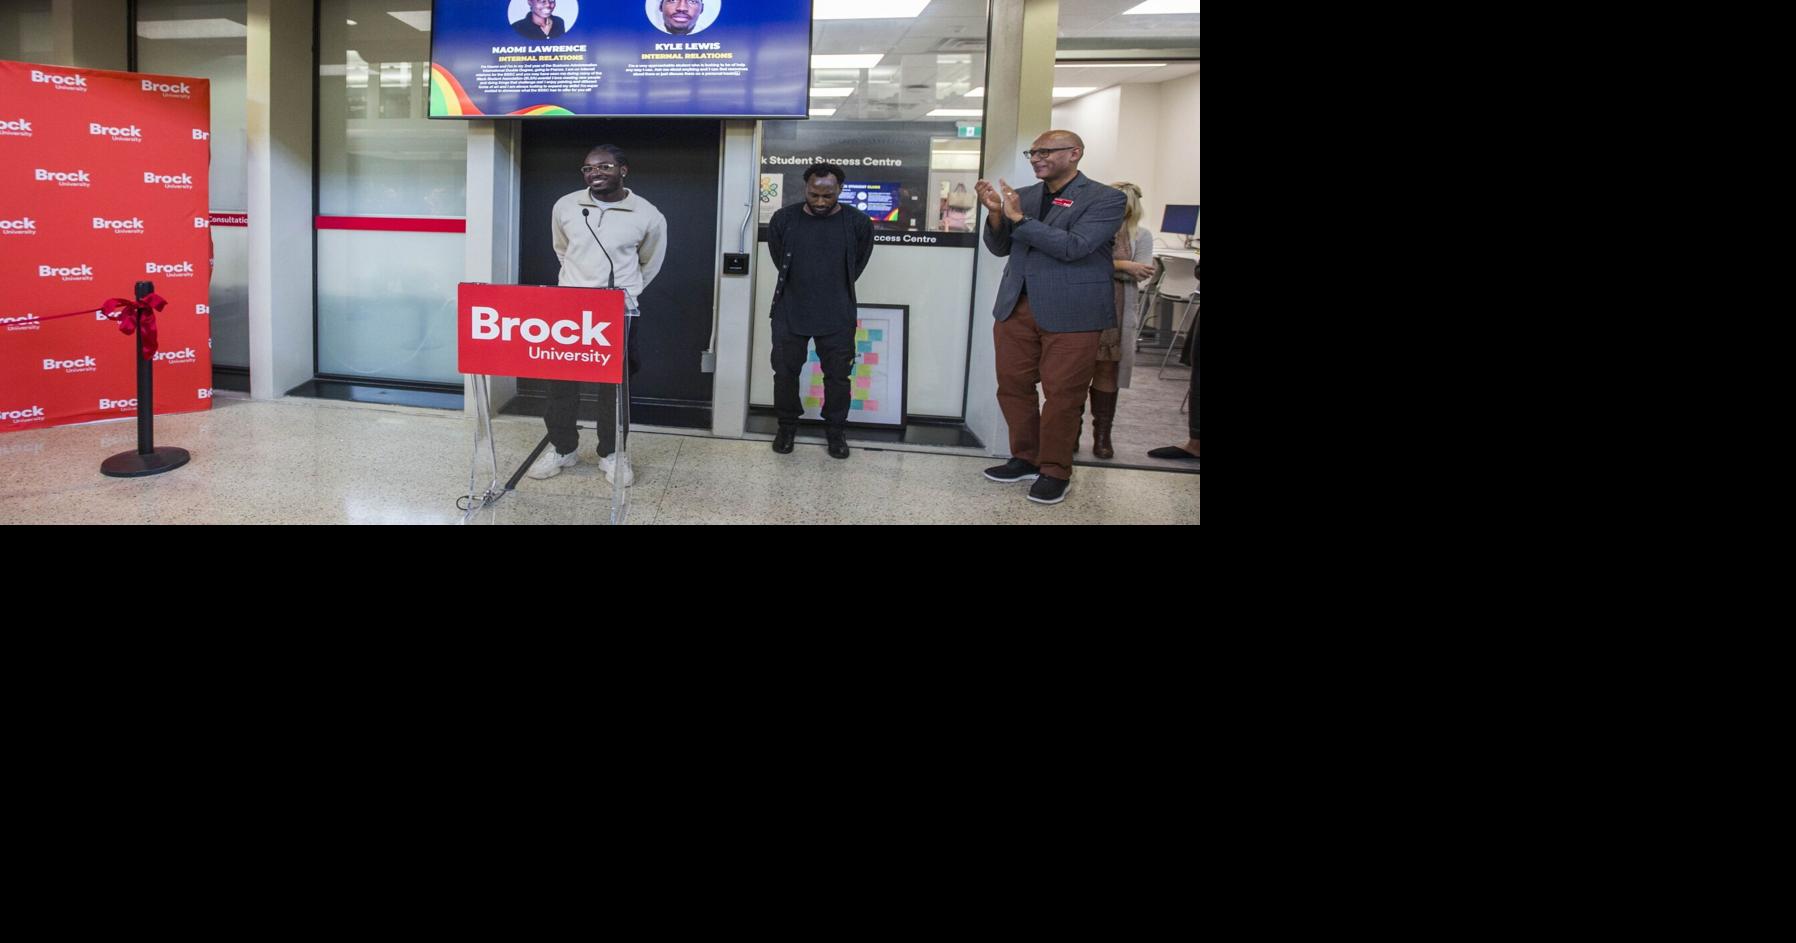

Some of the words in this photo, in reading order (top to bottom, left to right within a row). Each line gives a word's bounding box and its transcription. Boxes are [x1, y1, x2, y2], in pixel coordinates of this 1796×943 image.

[492, 46, 526, 54] NAOMI
[528, 45, 587, 53] LAWRENCE
[685, 42, 720, 50] LEWIS
[31, 70, 87, 87] Brock
[141, 79, 190, 94] Brock
[0, 118, 32, 131] ock
[90, 123, 142, 137] Brock
[769, 156, 813, 165] Student
[863, 156, 902, 166] Centre
[35, 168, 90, 182] Brock
[144, 172, 192, 184] Brock
[0, 217, 36, 229] ock
[92, 217, 144, 229] Brock
[209, 215, 248, 225] Consultatio
[903, 234, 937, 244] Centre
[38, 264, 93, 277] Brock
[145, 261, 193, 273] Brock
[471, 306, 612, 347] Brock
[528, 346, 612, 367] University
[43, 356, 96, 370] Brock
[99, 398, 138, 410] Broc
